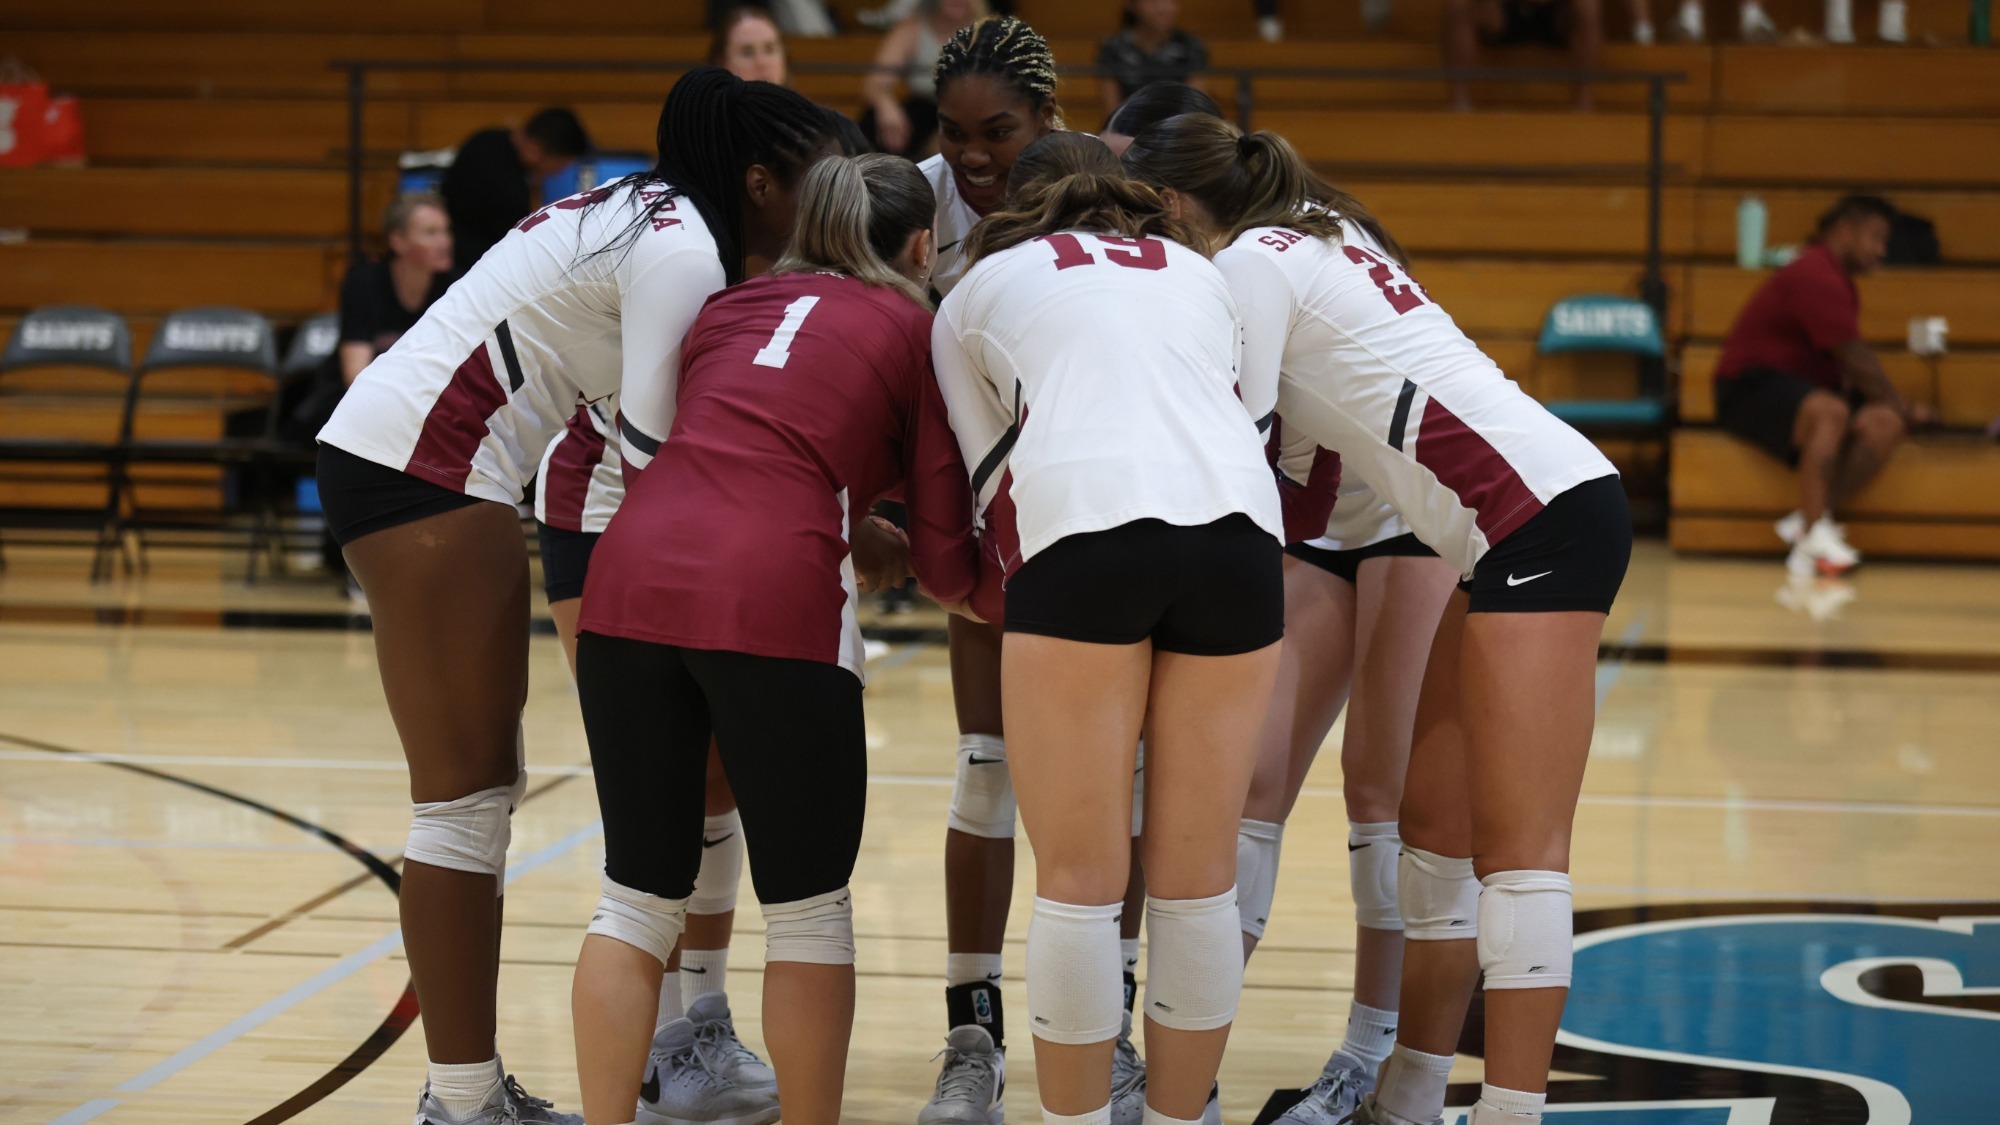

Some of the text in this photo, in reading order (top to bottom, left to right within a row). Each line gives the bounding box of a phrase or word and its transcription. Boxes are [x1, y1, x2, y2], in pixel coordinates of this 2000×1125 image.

[640, 182, 682, 232] ARA
[1033, 234, 1168, 271] 19
[164, 321, 260, 352] SAINTS
[752, 296, 820, 369] 1
[1552, 303, 1651, 336] SAINTS
